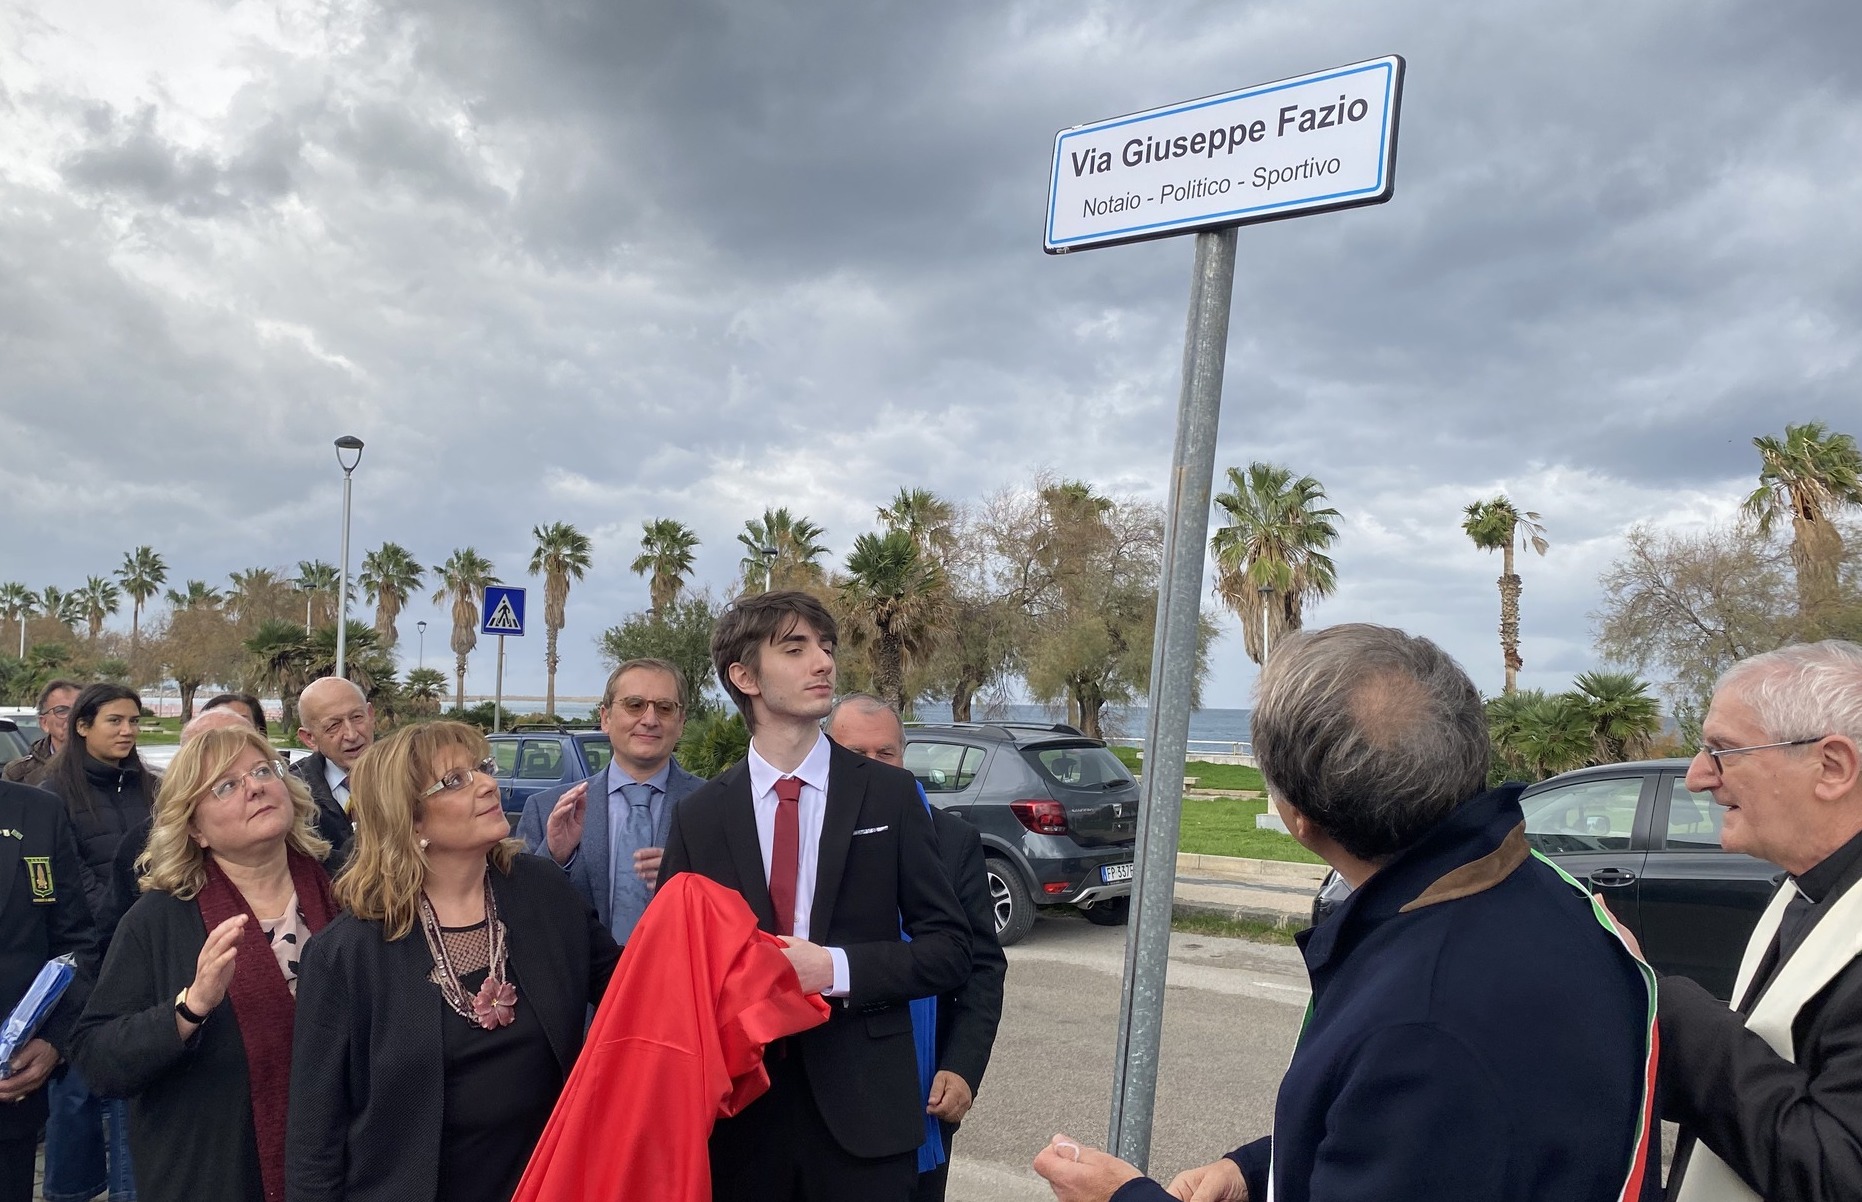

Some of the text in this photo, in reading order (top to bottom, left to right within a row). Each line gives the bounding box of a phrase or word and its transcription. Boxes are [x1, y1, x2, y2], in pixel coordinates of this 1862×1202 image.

[1071, 94, 1369, 177] Via Giuseppe Fazio
[1083, 194, 1141, 218] Notaio
[1160, 178, 1231, 205] Politico
[1252, 157, 1341, 191] Sportivo
